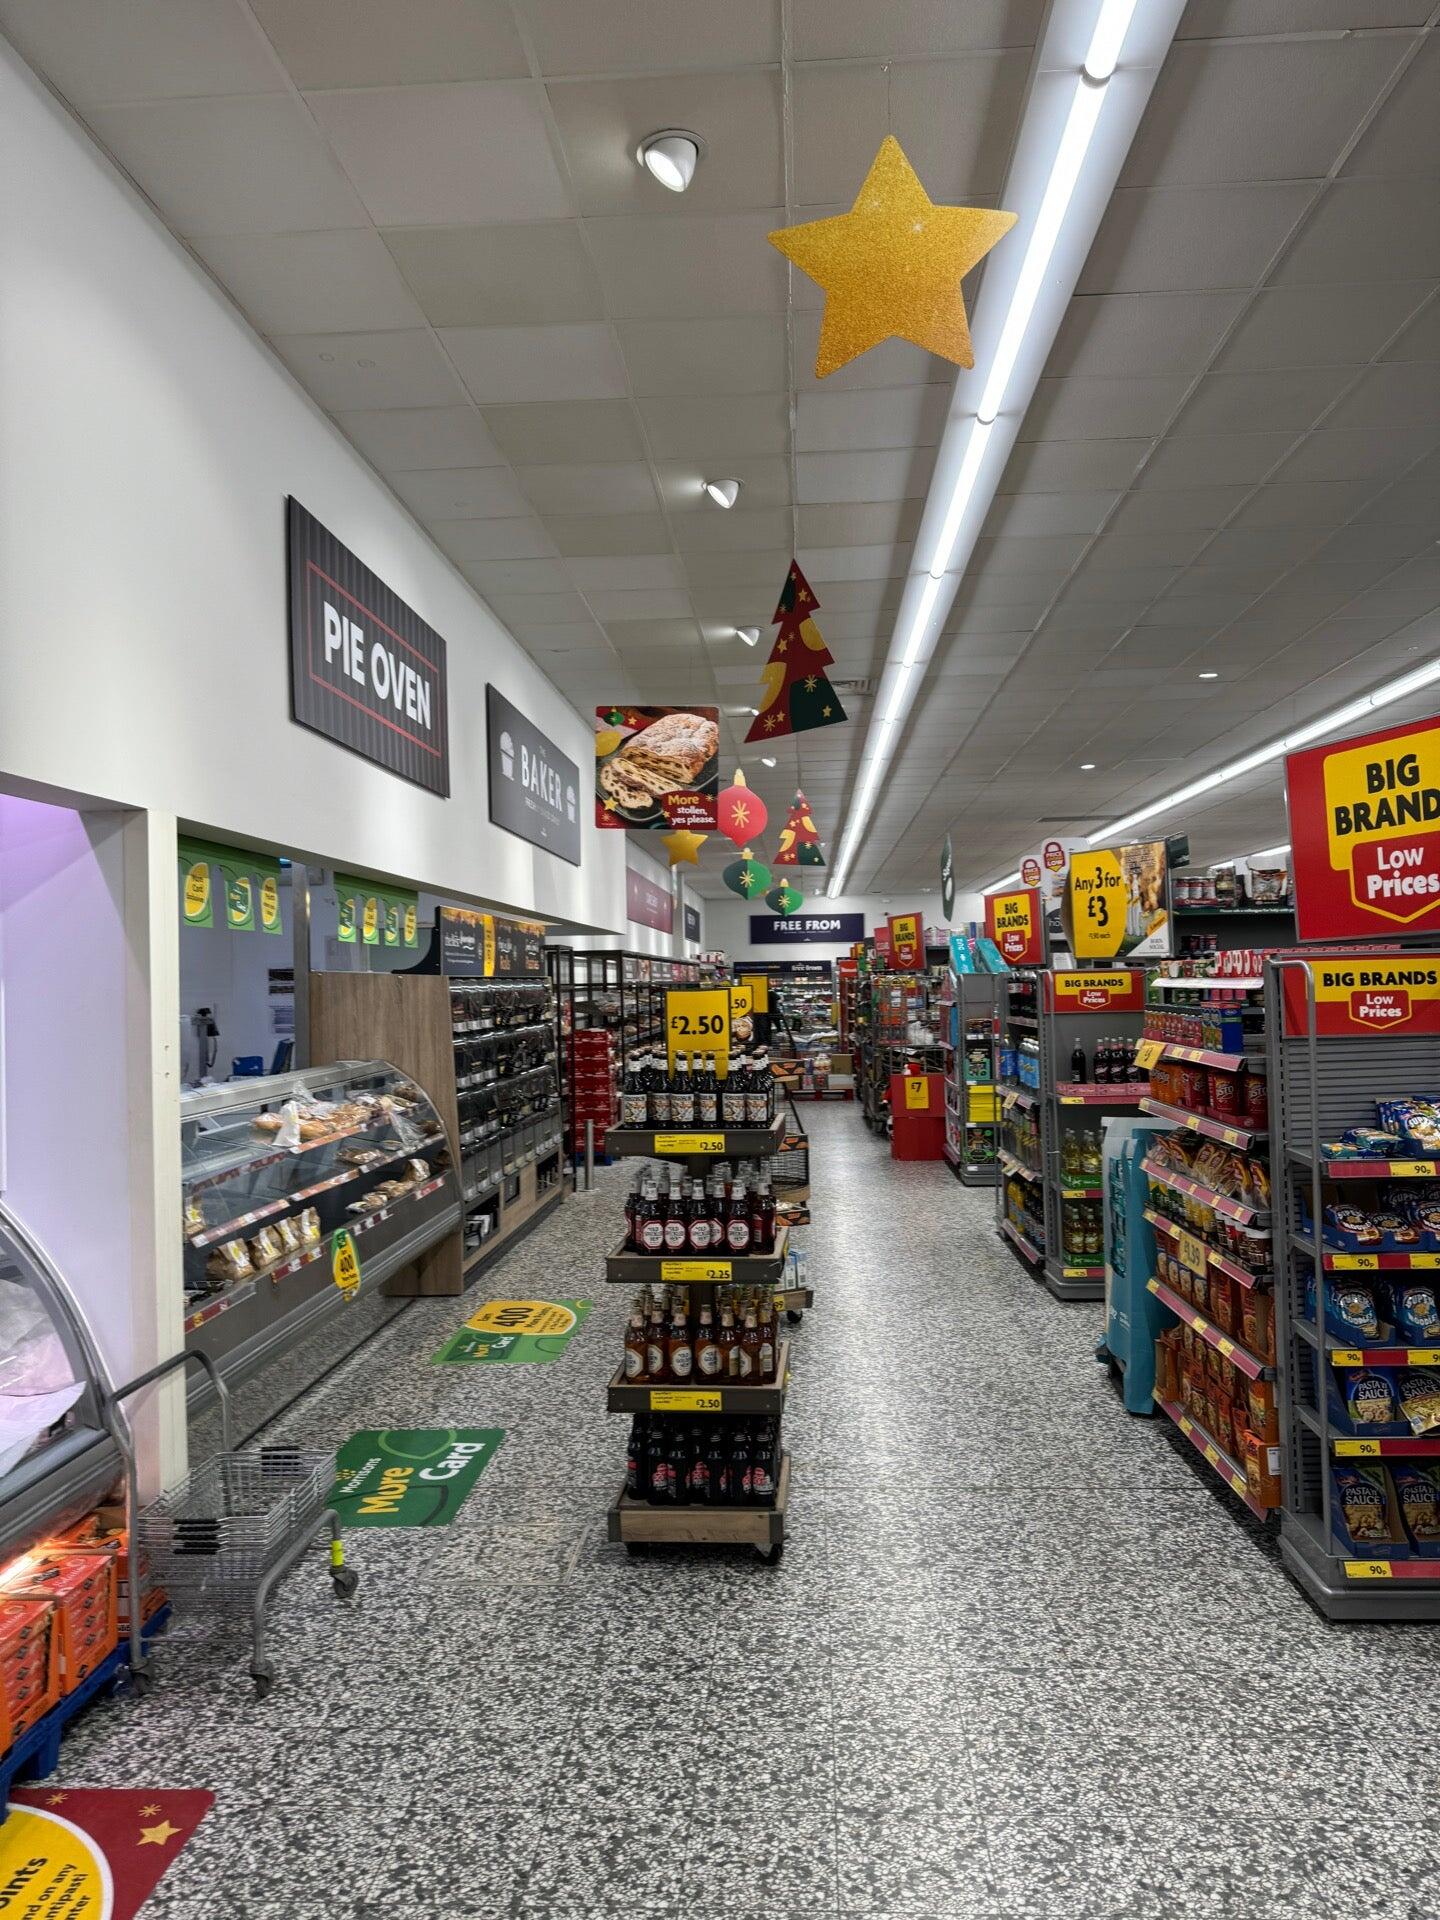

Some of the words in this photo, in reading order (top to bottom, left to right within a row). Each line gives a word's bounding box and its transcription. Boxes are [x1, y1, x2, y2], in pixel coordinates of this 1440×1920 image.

[323, 600, 366, 686] PIE
[371, 642, 431, 730] OVEN
[520, 745, 562, 812] BAKER
[1366, 754, 1420, 794] BIG
[668, 794, 700, 805] More
[676, 806, 708, 815] stollen,
[1334, 788, 1440, 836] BRAND
[672, 817, 686, 826] yes
[686, 815, 716, 826] please.
[1376, 846, 1424, 871] Low
[1075, 877, 1094, 893] Any
[1096, 867, 1103, 889] 3
[1105, 872, 1121, 888] for
[1366, 870, 1440, 900] Prices
[1004, 902, 1018, 914] BIG
[1088, 896, 1109, 927] £3
[774, 921, 802, 931] FREE
[805, 920, 841, 931] FROM
[997, 914, 1029, 928] BRANDS
[1007, 933, 1020, 942] Low
[1064, 980, 1081, 988] BIG
[1084, 979, 1124, 987] BRANDS
[1323, 973, 1355, 987] BIG
[1360, 971, 1438, 986] BRANDS
[731, 998, 747, 1009] .50
[1366, 994, 1394, 1005] Low
[1359, 1006, 1402, 1018] Prices
[671, 1015, 724, 1035] £2.50
[911, 1082, 922, 1093] £7
[700, 1142, 723, 1151] £2.50
[1414, 1165, 1431, 1174] 90p
[1358, 1259, 1375, 1268] 90p
[707, 1270, 730, 1279] £2.25
[492, 1307, 534, 1328] 400
[1347, 1354, 1361, 1362] 90p
[1358, 1389, 1389, 1400] SAUCE
[1404, 1386, 1439, 1399] SAUCE
[696, 1399, 720, 1408] £2.50
[1360, 1445, 1377, 1454] 90p
[419, 1443, 486, 1481] Card
[338, 1457, 382, 1493] Morrisons
[357, 1467, 415, 1514] More
[1346, 1496, 1381, 1505] SAUCE
[1404, 1493, 1437, 1504] SAUCE
[1370, 1566, 1387, 1576] 90p
[22, 1905, 42, 1920] nd
[38, 1886, 58, 1902] on
[52, 1864, 78, 1884] any
[44, 1874, 89, 1920] ntipasti
[65, 1895, 92, 1920] nter
